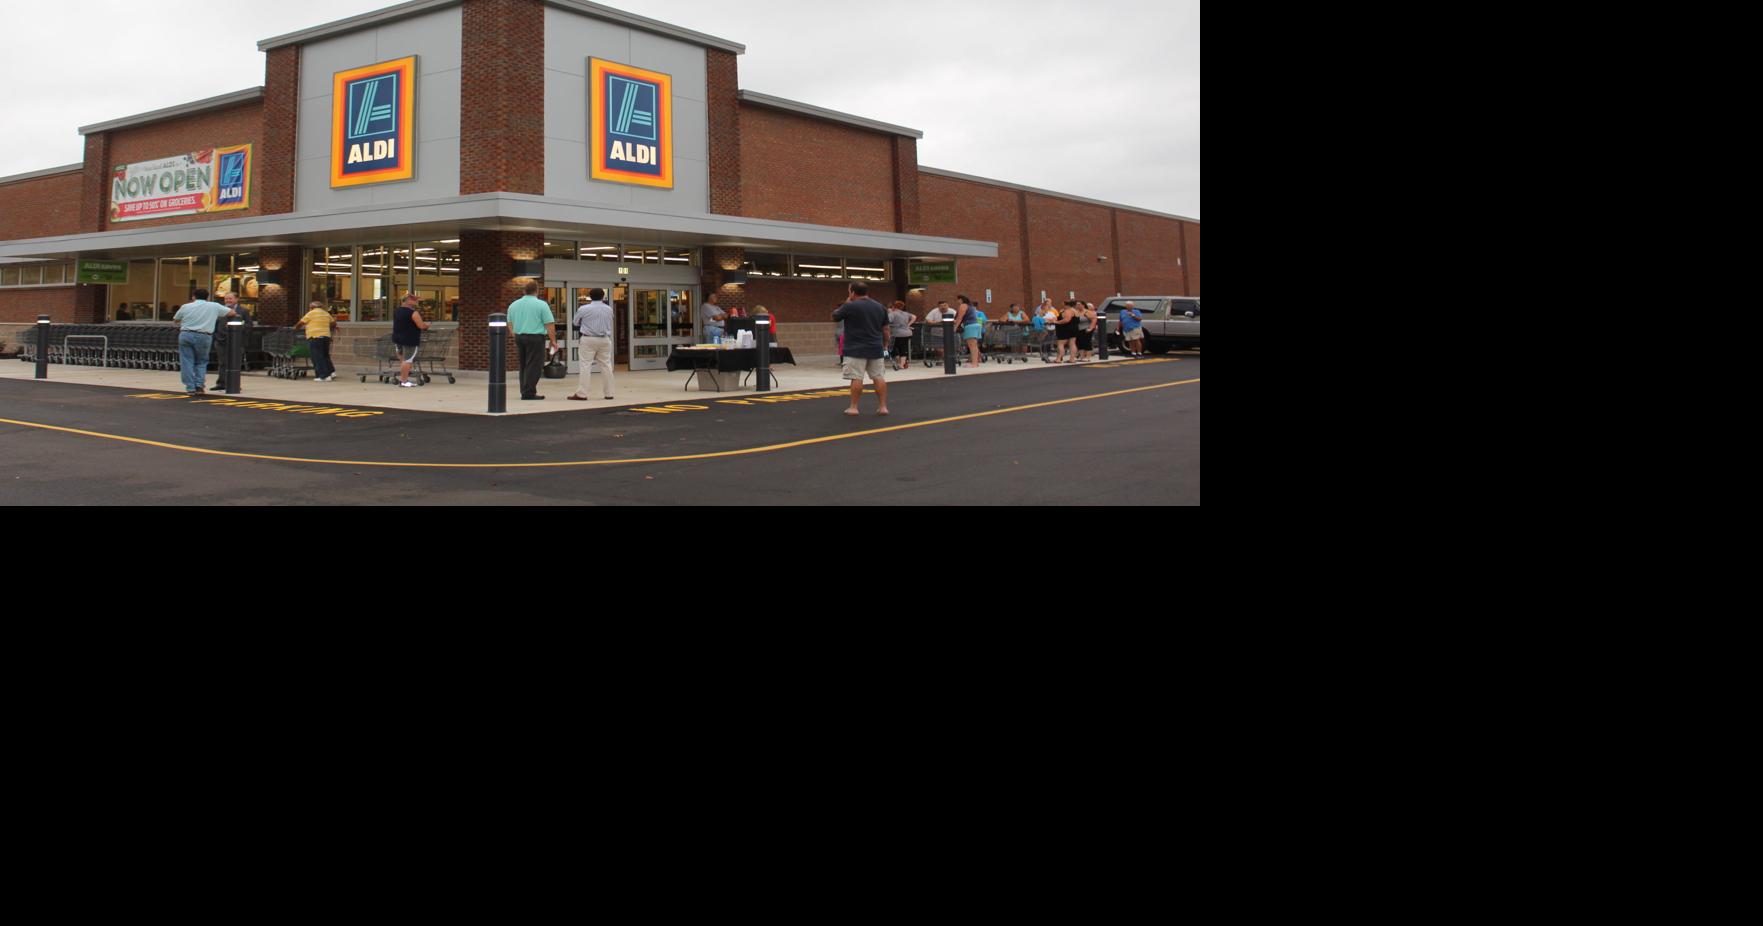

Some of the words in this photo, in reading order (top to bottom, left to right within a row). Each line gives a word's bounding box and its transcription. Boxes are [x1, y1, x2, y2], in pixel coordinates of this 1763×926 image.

[347, 138, 395, 164] ALDI
[610, 140, 657, 165] ALDI
[115, 173, 157, 200] NOW
[159, 165, 211, 194] OPEN
[219, 186, 242, 199] ALDI
[191, 398, 385, 418] PARKING
[628, 404, 709, 414] NO
